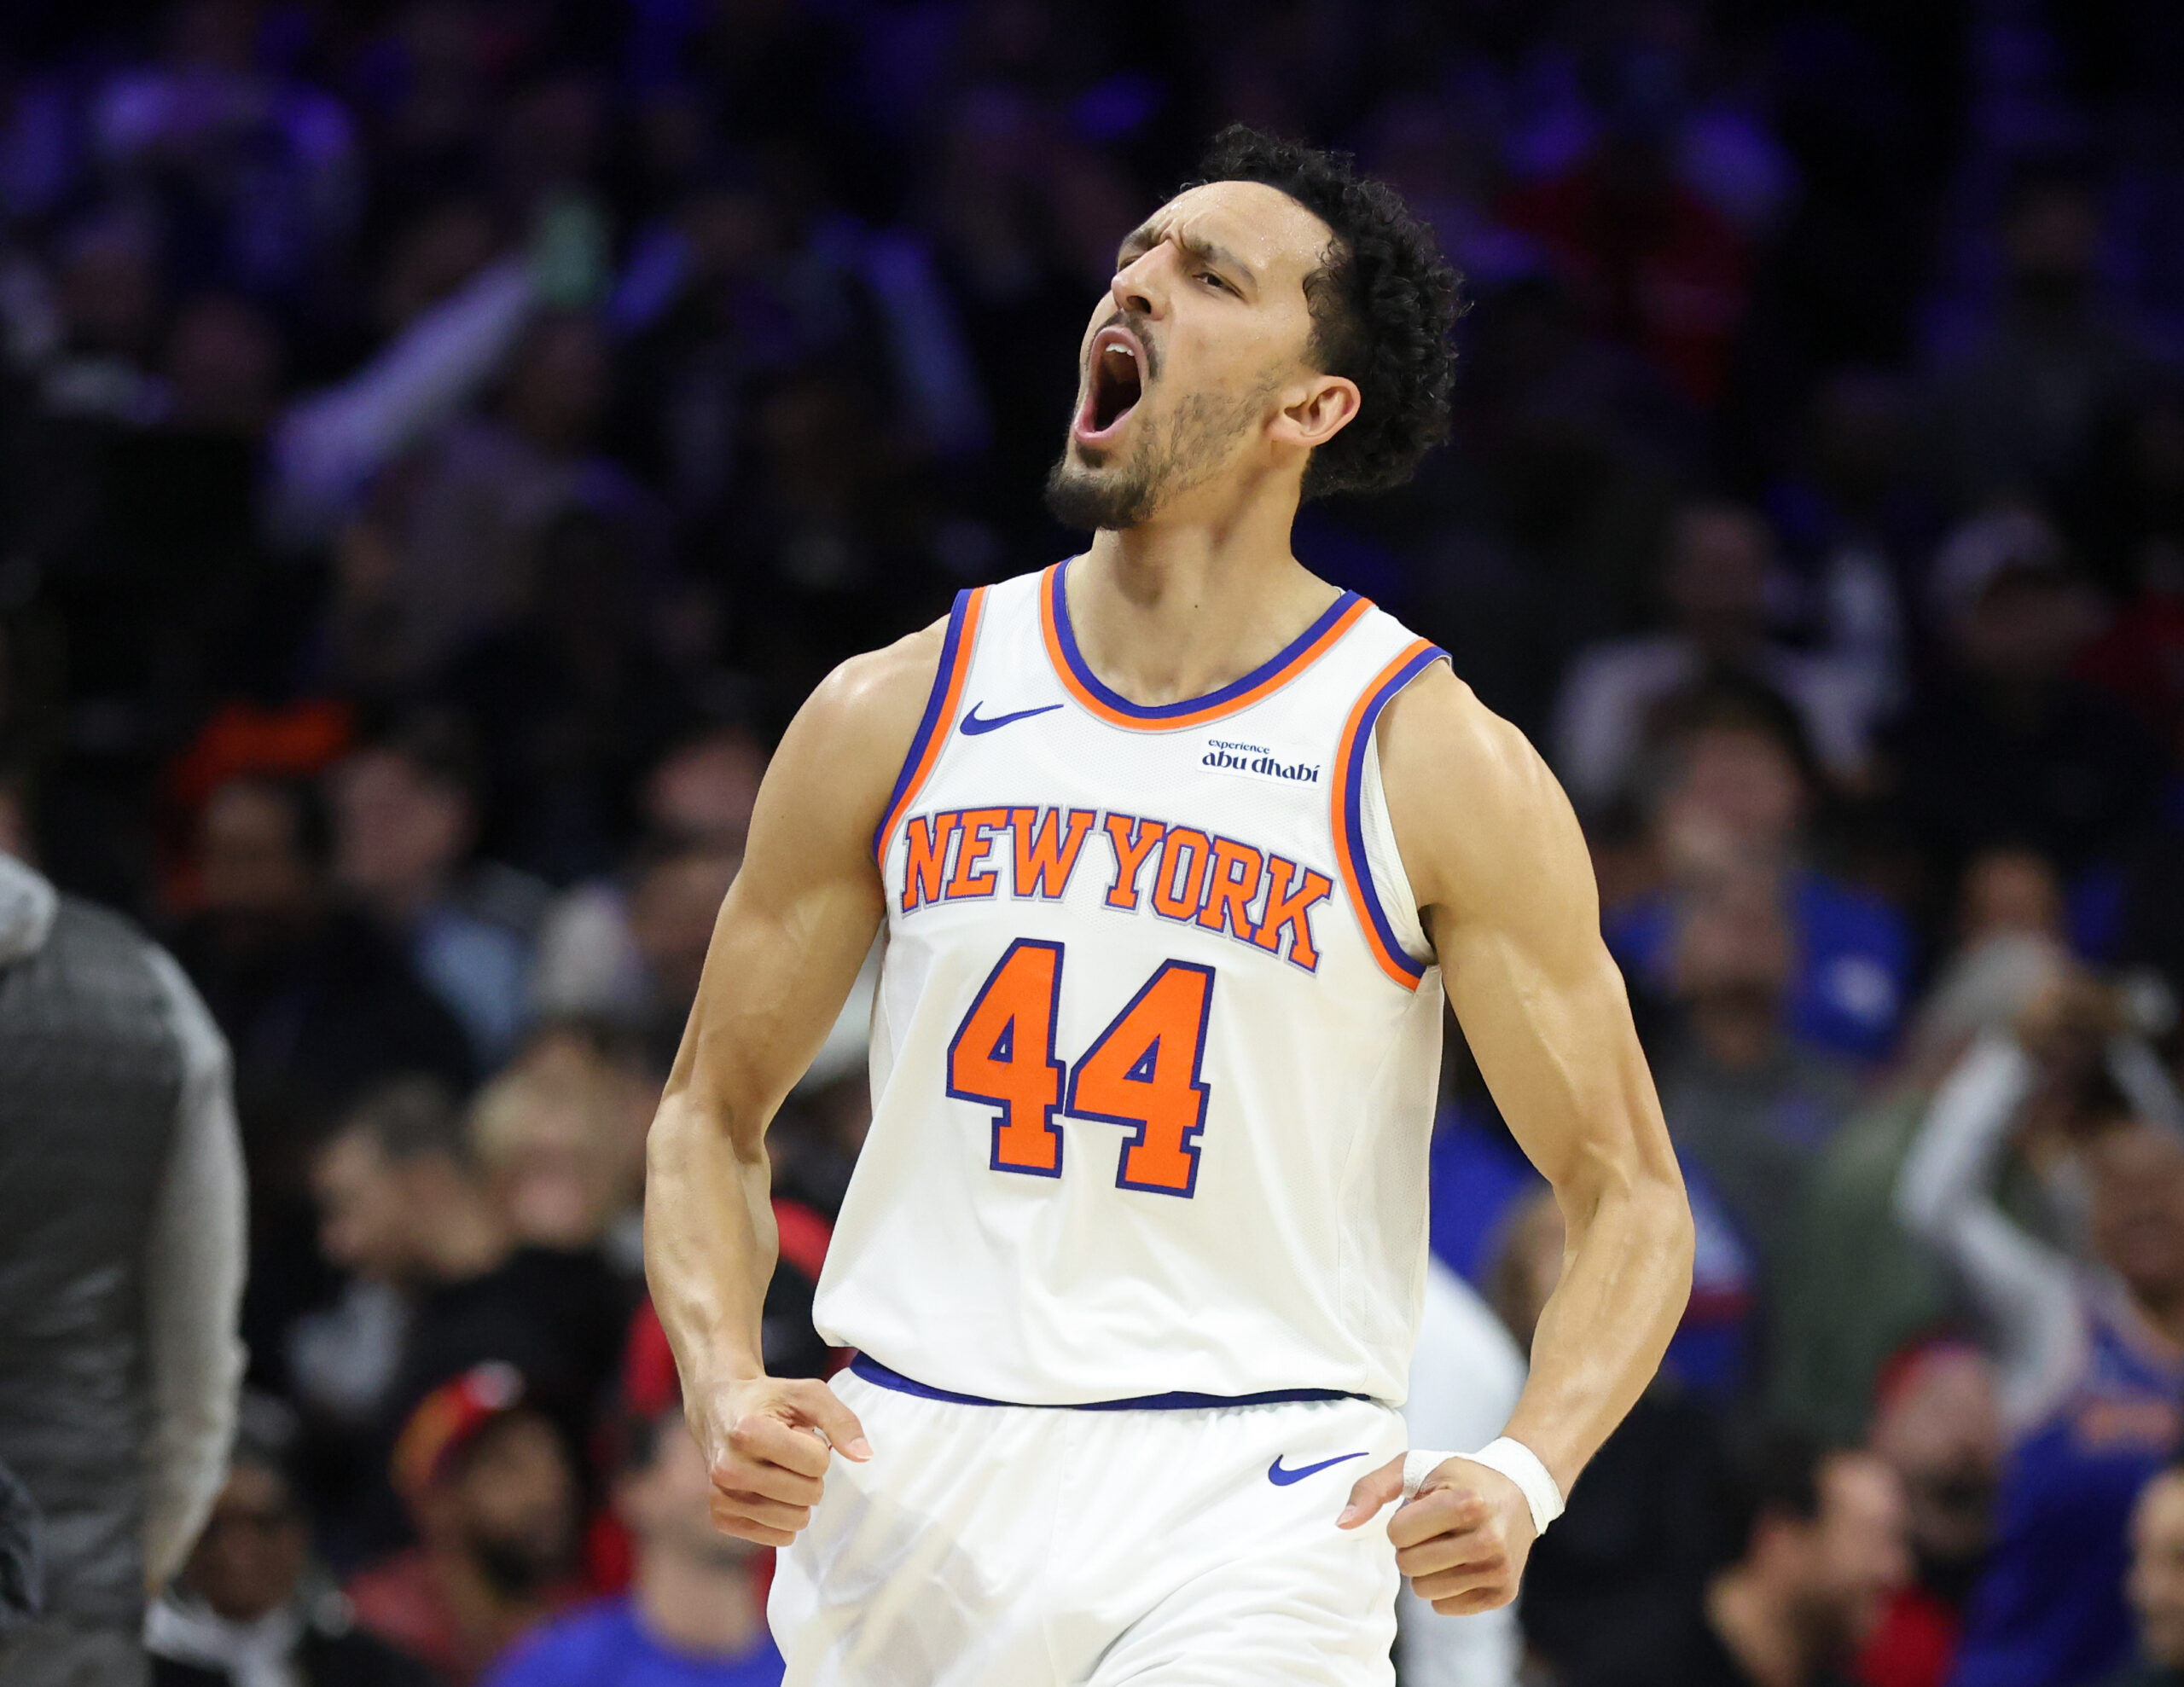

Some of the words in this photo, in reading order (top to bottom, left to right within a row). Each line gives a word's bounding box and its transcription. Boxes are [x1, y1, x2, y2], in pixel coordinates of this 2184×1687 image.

[1202, 751, 1247, 770] abu
[1208, 739, 1270, 754] experience
[901, 805, 1098, 916] NEW
[1103, 808, 1334, 974] YORK
[945, 936, 1216, 1199] 44
